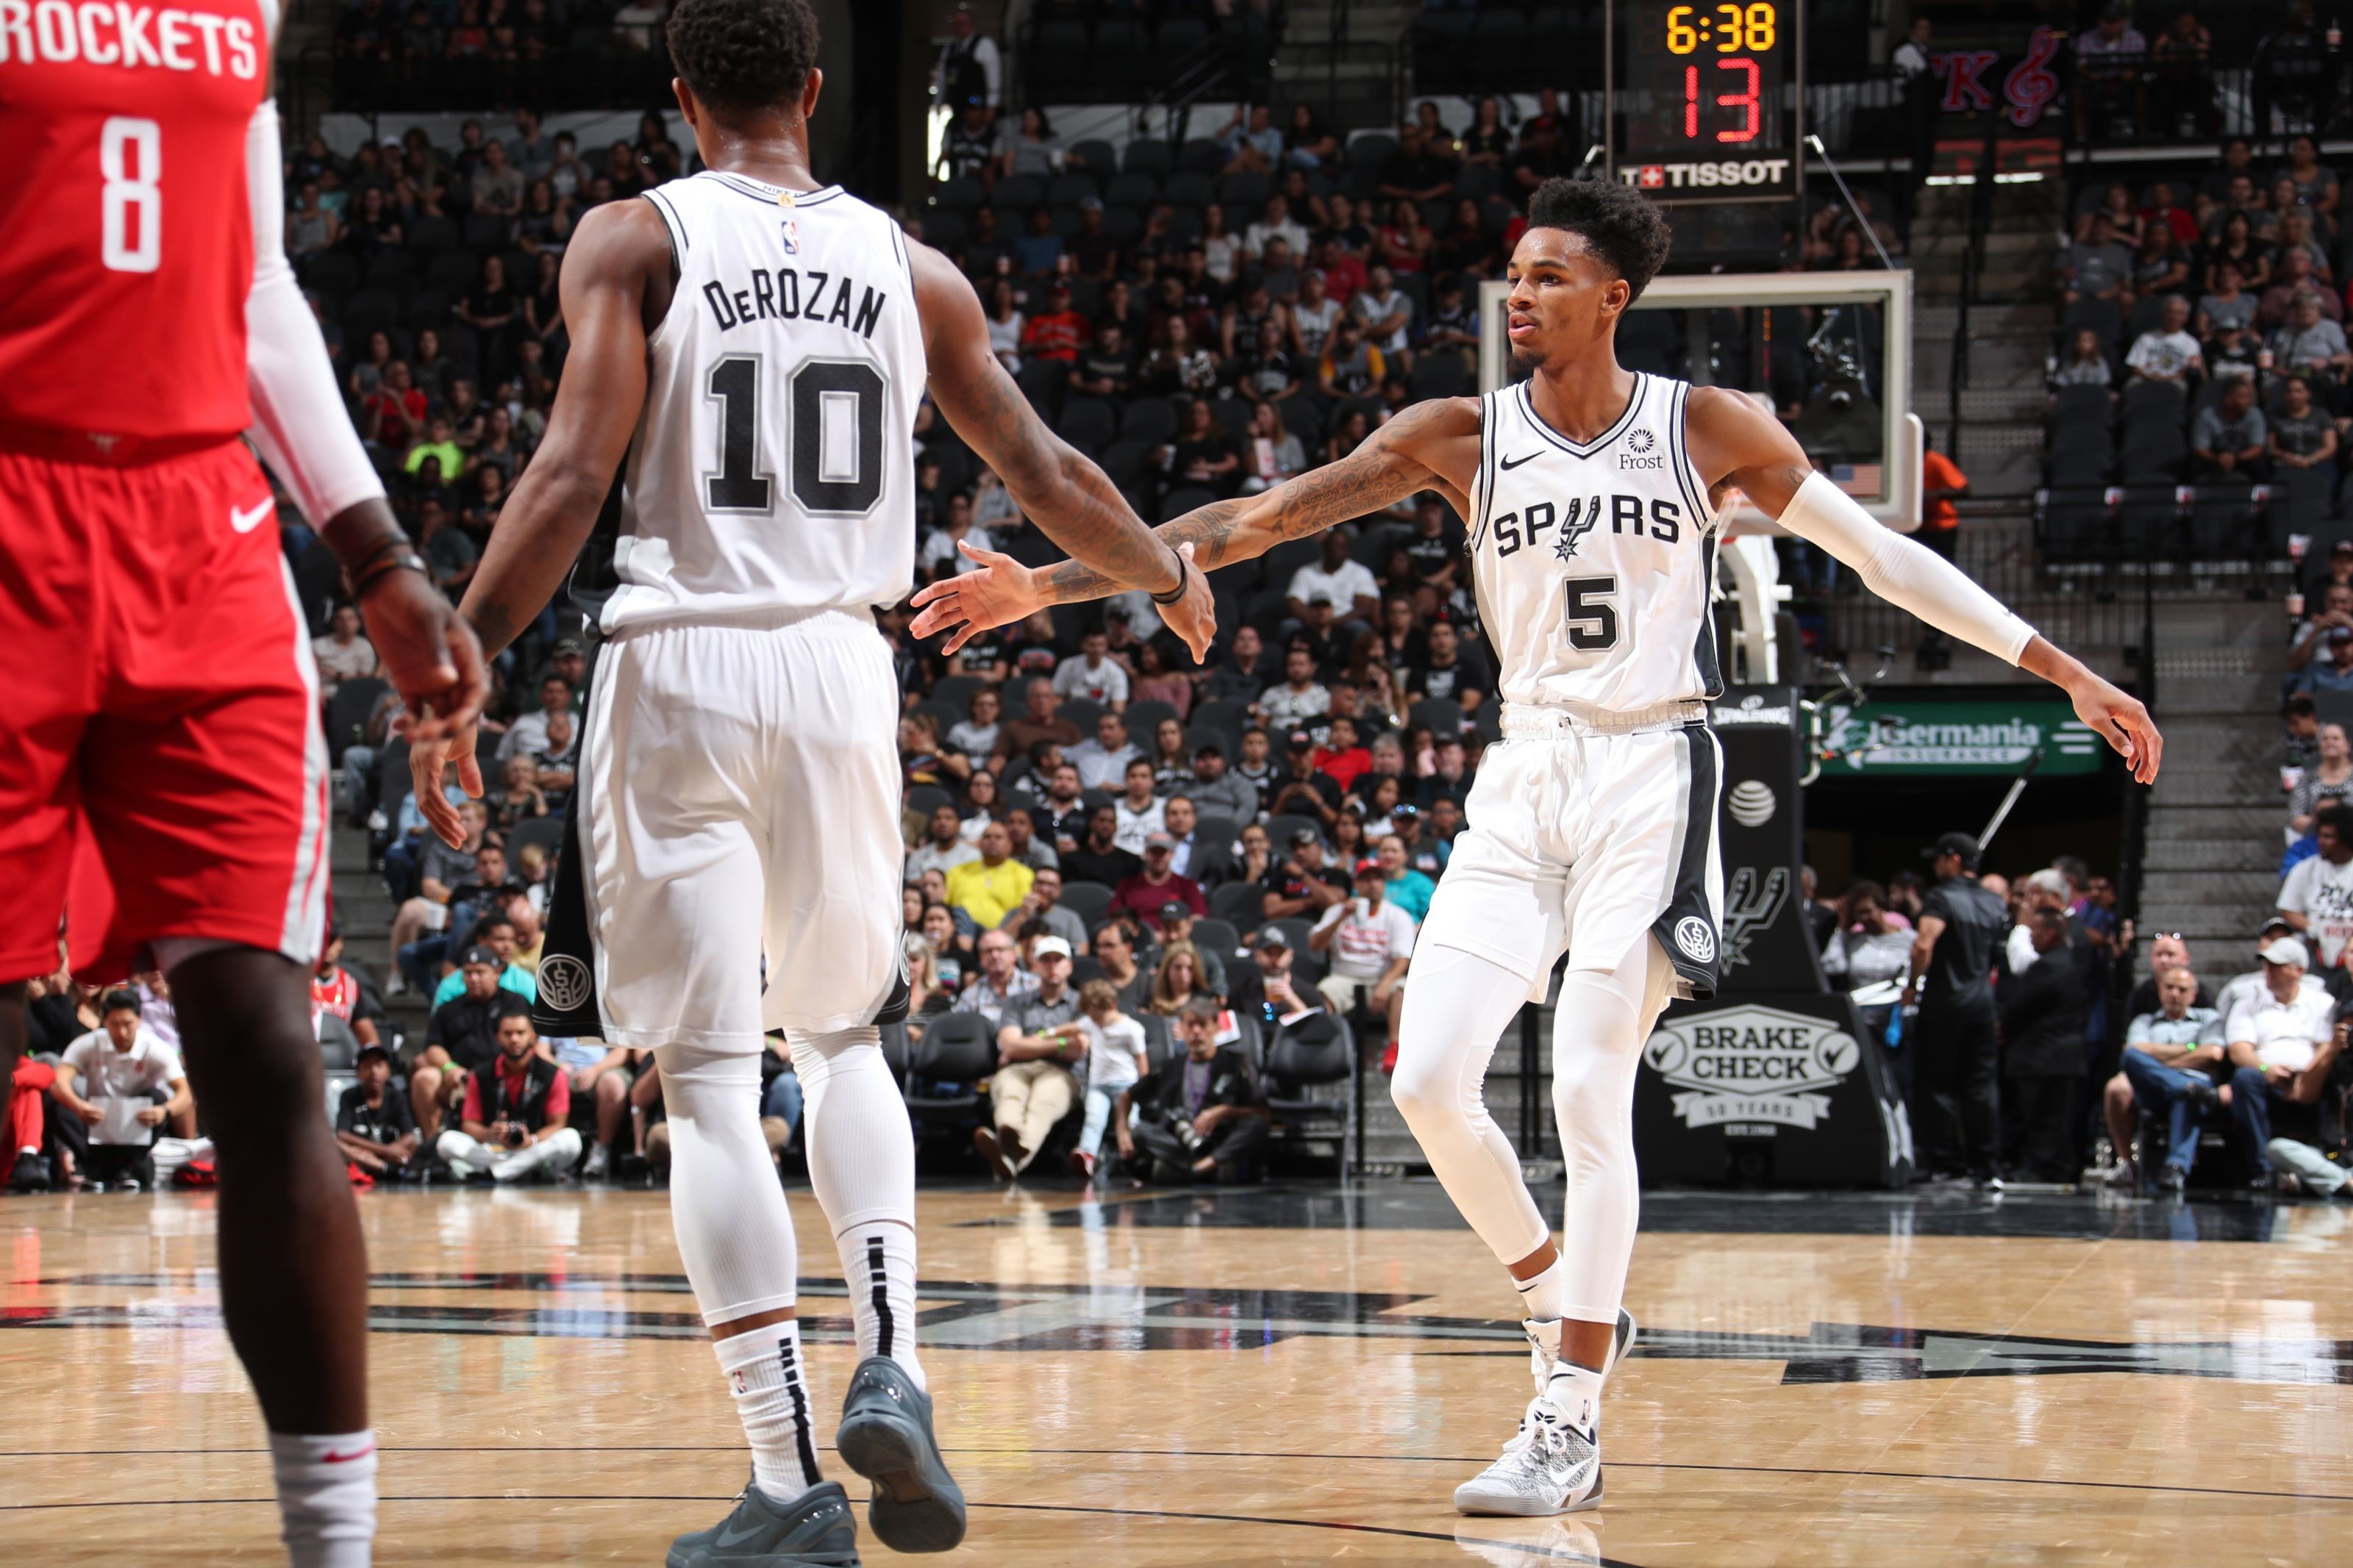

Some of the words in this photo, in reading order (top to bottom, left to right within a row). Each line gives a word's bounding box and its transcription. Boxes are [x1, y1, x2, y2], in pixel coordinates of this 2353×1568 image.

[0, 0, 256, 79] ROCKETS
[1667, 3, 1775, 54] 6:38
[1685, 58, 1760, 142] 13
[101, 115, 161, 273] 8
[1665, 160, 1790, 187] TISSOT
[703, 268, 887, 340] DeROZAN
[701, 352, 890, 519] 10
[1618, 454, 1663, 470] Frost
[1493, 495, 1680, 564] SPURS
[1563, 575, 1618, 653] 5
[1881, 717, 2040, 746] Germania
[1692, 1056, 1809, 1079] CHECK
[1693, 1027, 1810, 1050] BRAKE
[1736, 1101, 1794, 1118] YEARS
